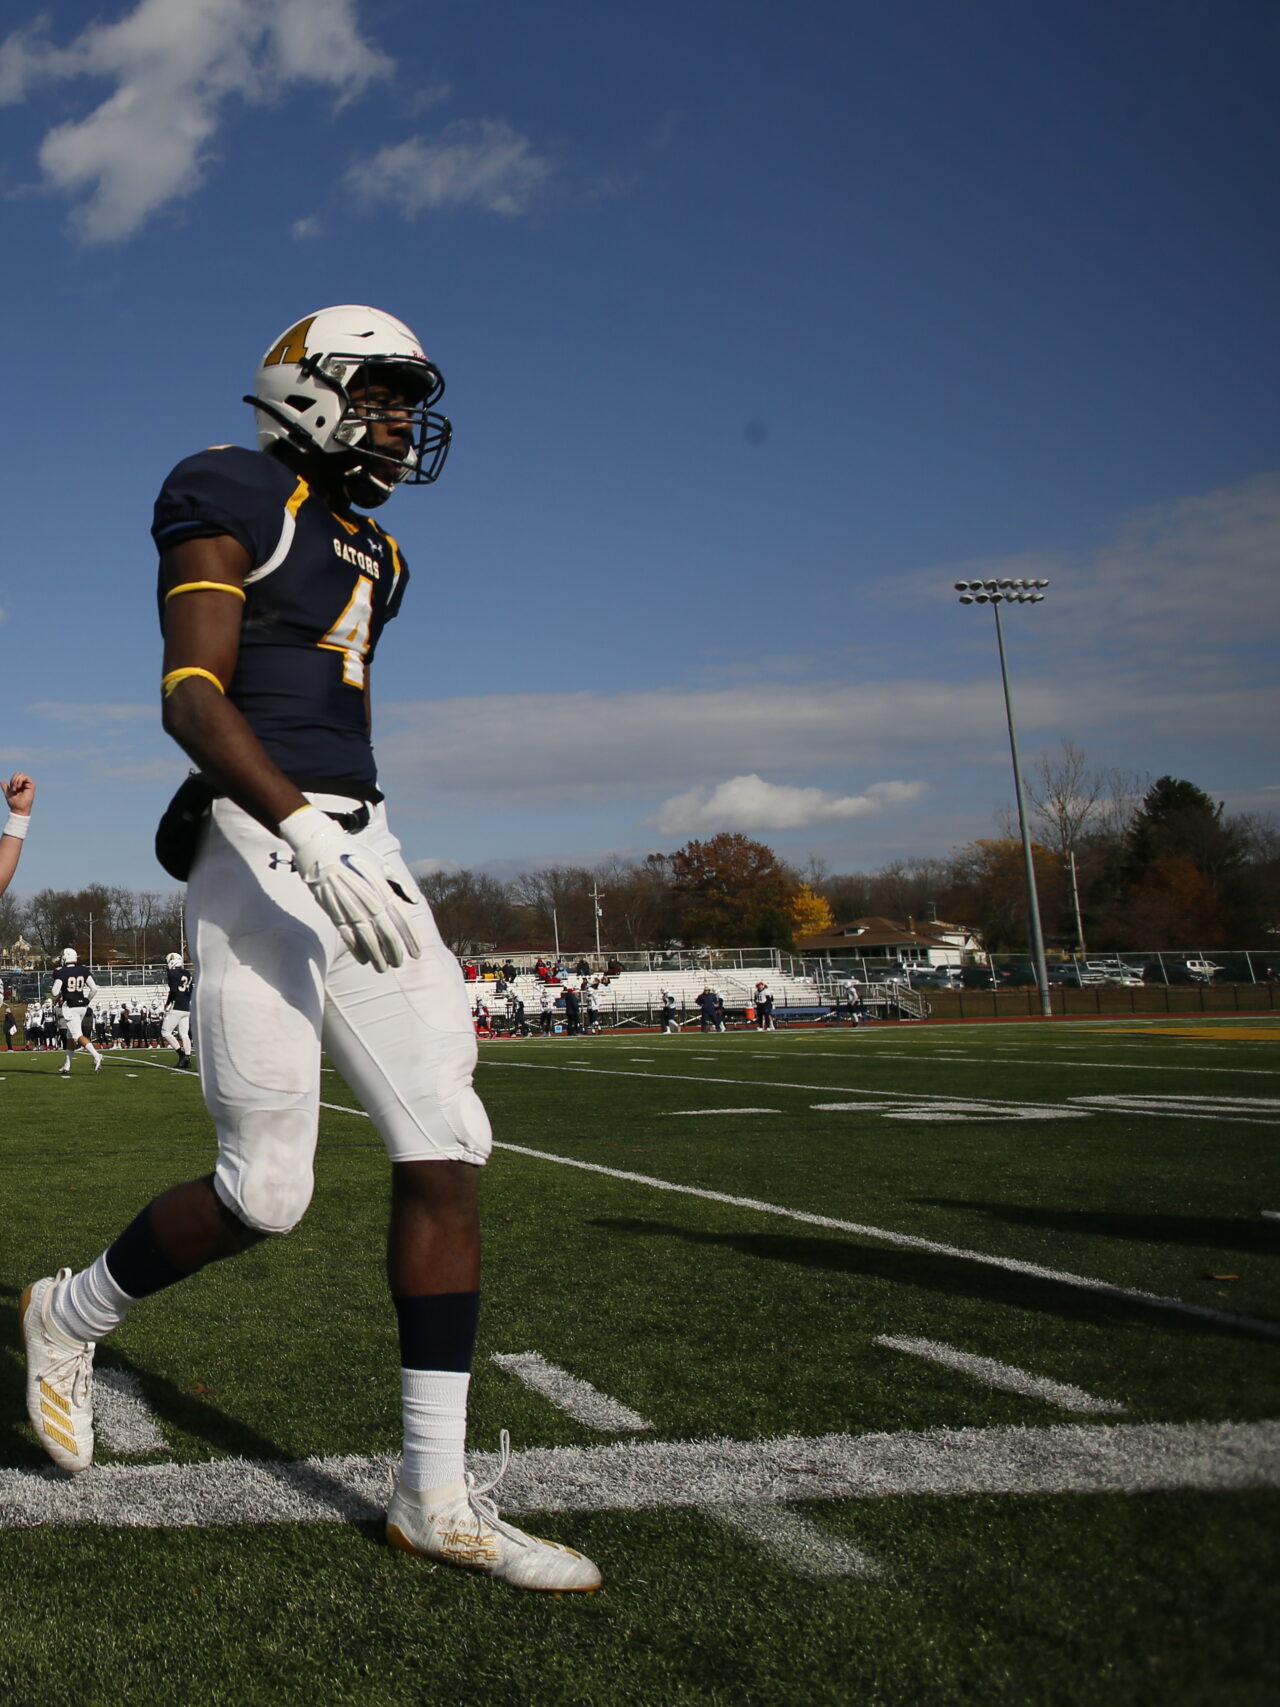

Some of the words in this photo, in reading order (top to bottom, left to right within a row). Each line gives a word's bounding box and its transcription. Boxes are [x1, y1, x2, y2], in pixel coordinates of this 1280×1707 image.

[332, 538, 380, 580] GATORS
[316, 574, 373, 690] 4
[67, 976, 85, 992] 90
